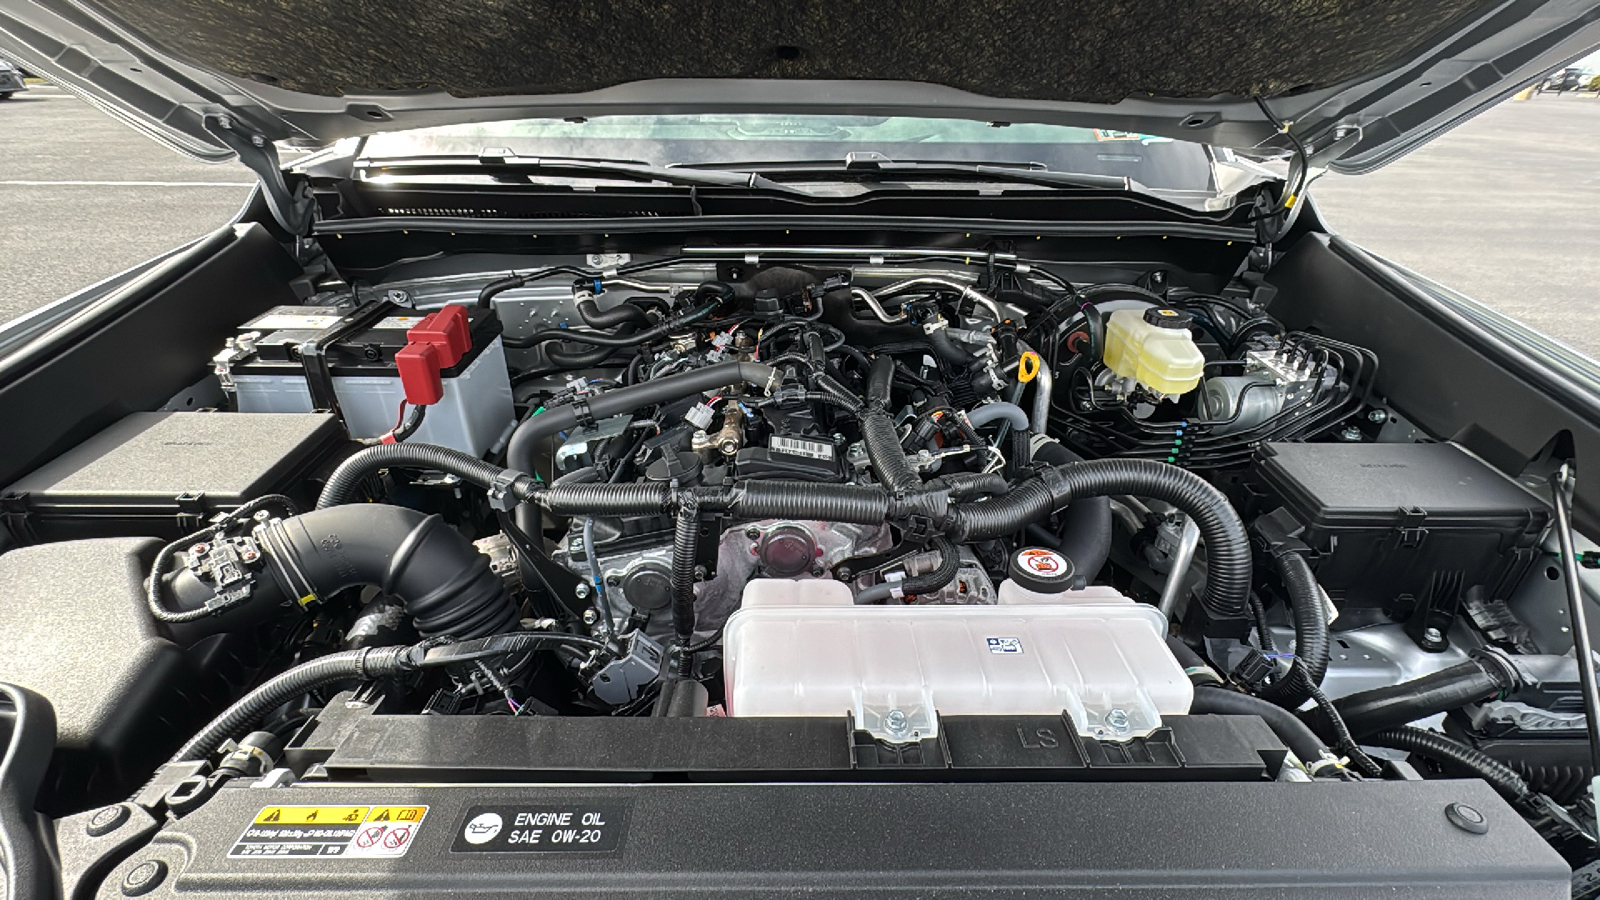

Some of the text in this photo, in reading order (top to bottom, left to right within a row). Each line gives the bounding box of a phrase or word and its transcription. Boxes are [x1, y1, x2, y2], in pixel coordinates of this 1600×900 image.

[1016, 726, 1059, 748] LS
[514, 812, 605, 826] ENGINE OIL
[507, 829, 542, 844] SAE
